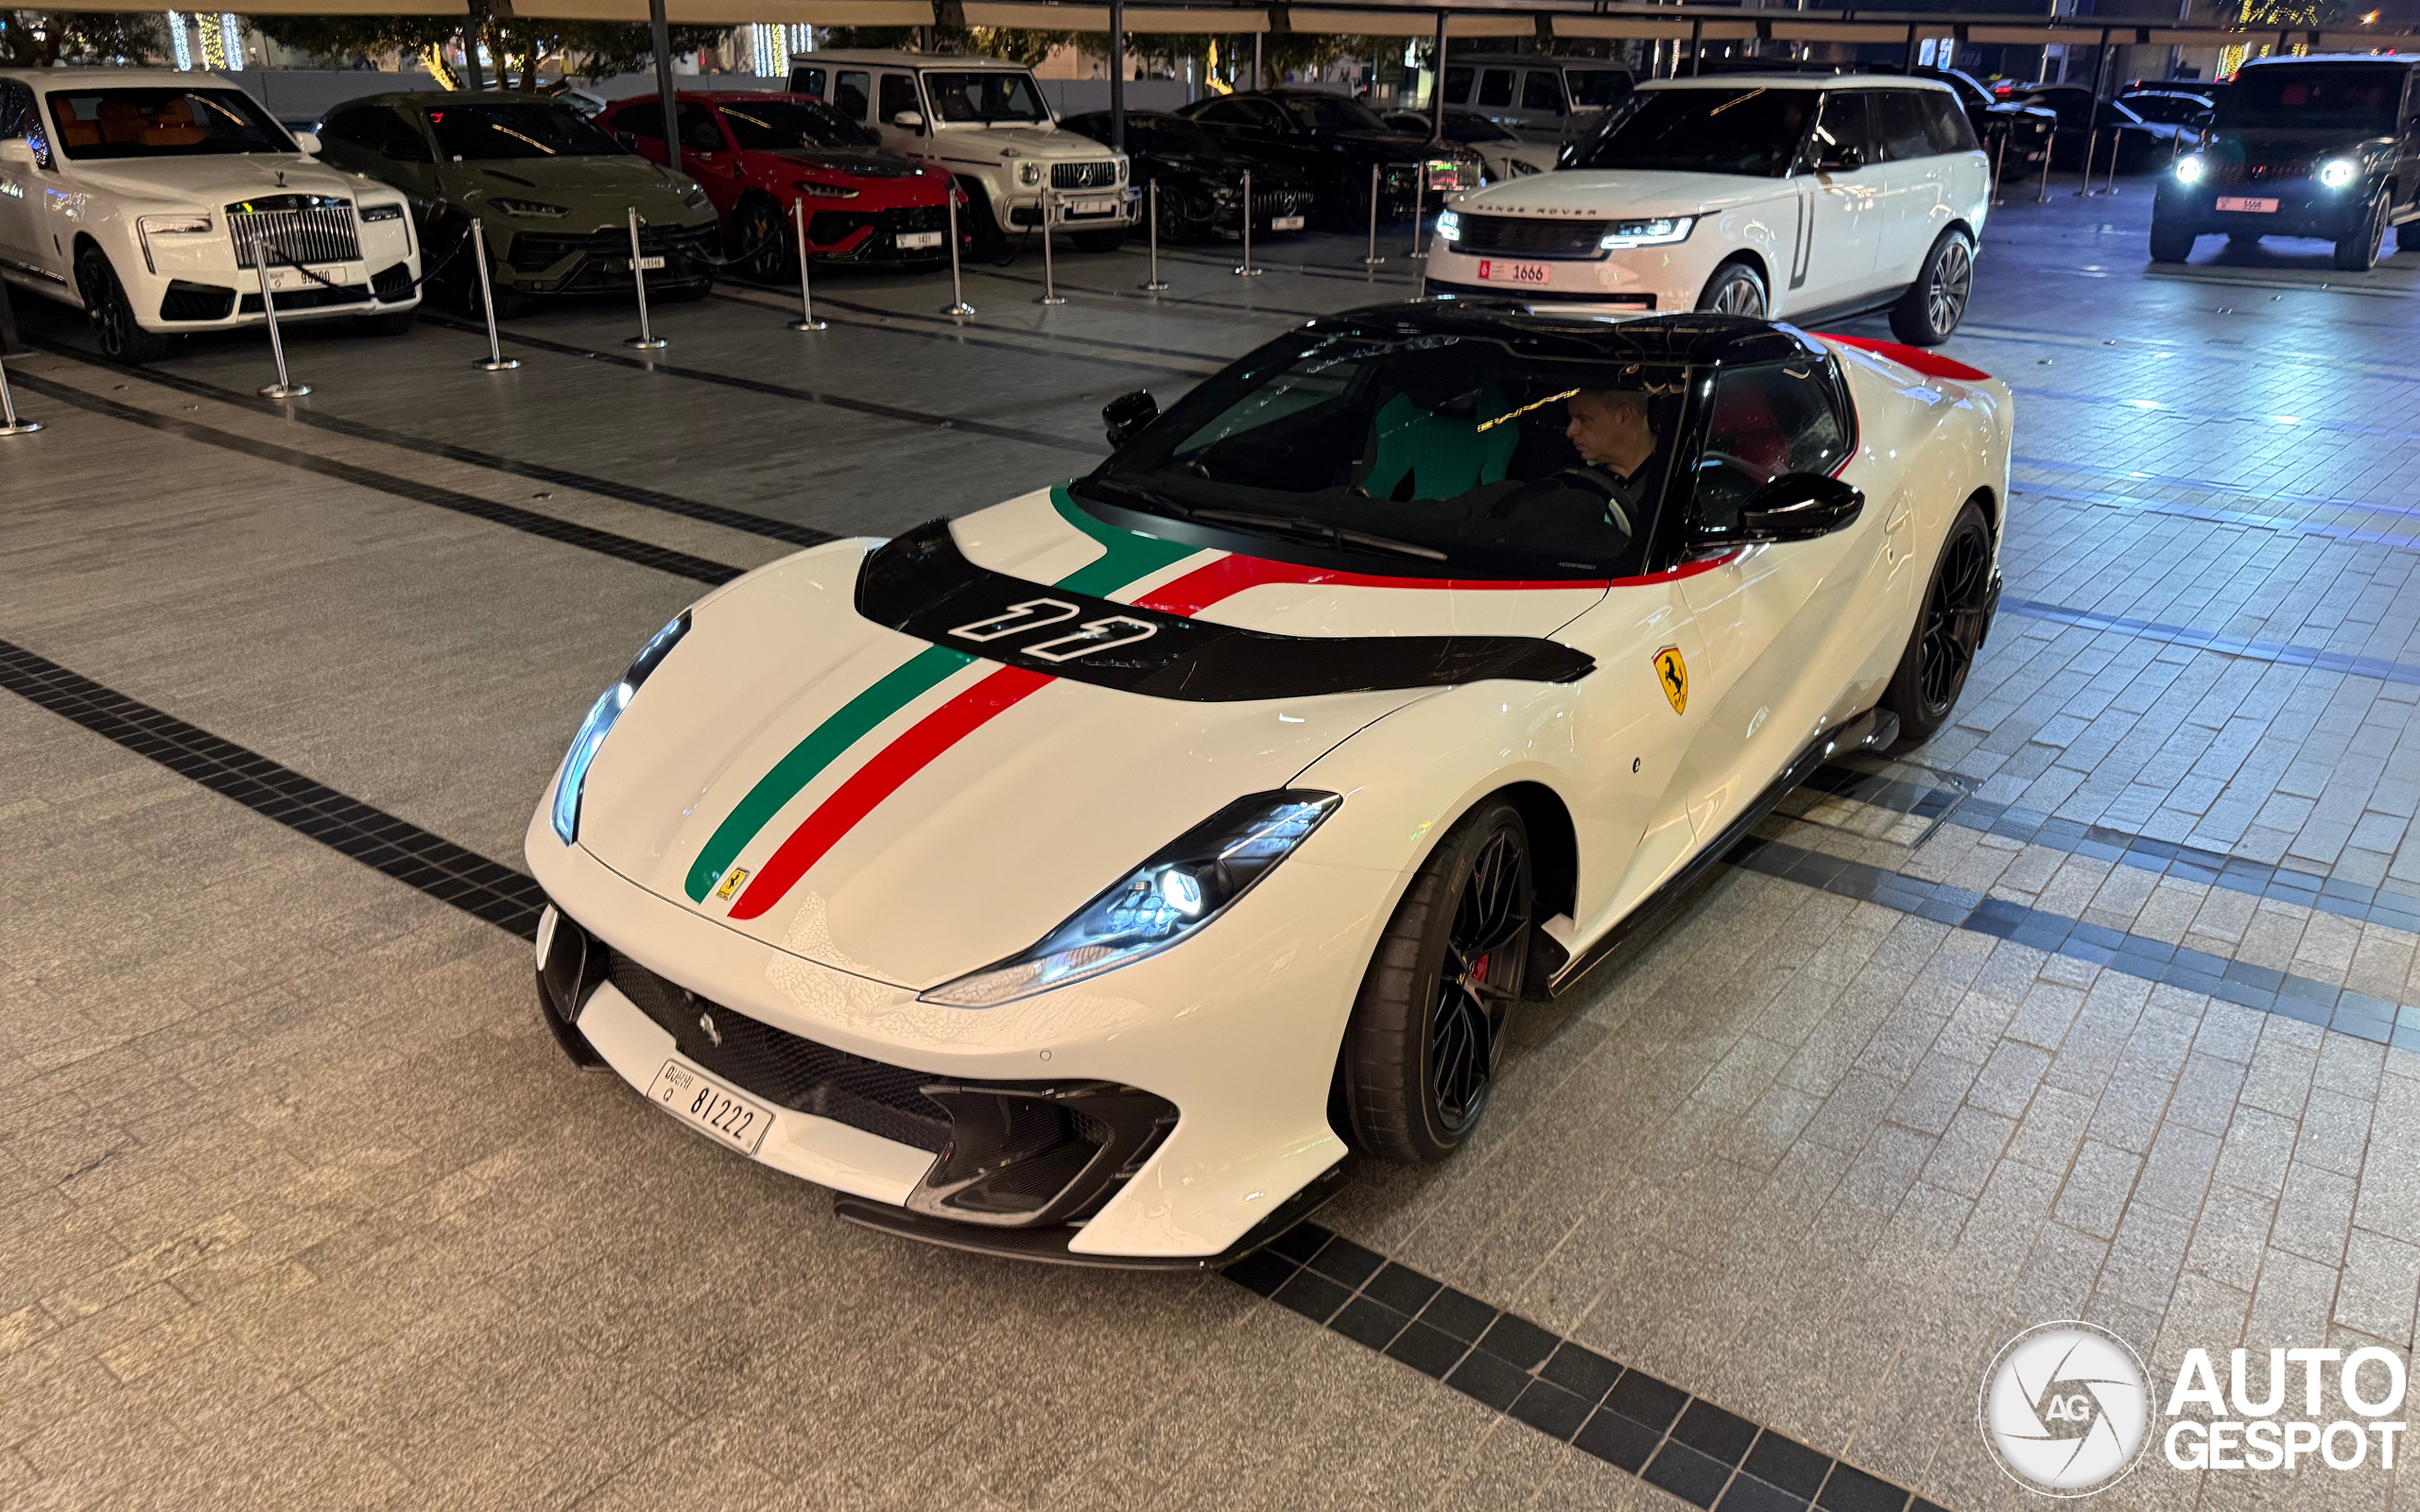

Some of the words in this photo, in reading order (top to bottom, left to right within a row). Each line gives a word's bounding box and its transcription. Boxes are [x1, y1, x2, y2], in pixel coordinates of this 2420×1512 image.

[1477, 204, 1525, 214] RANGE
[1537, 208, 1597, 216] ROVER
[1513, 265, 1543, 281] 1666
[663, 1088, 674, 1103] Q
[690, 1088, 754, 1140] 81222
